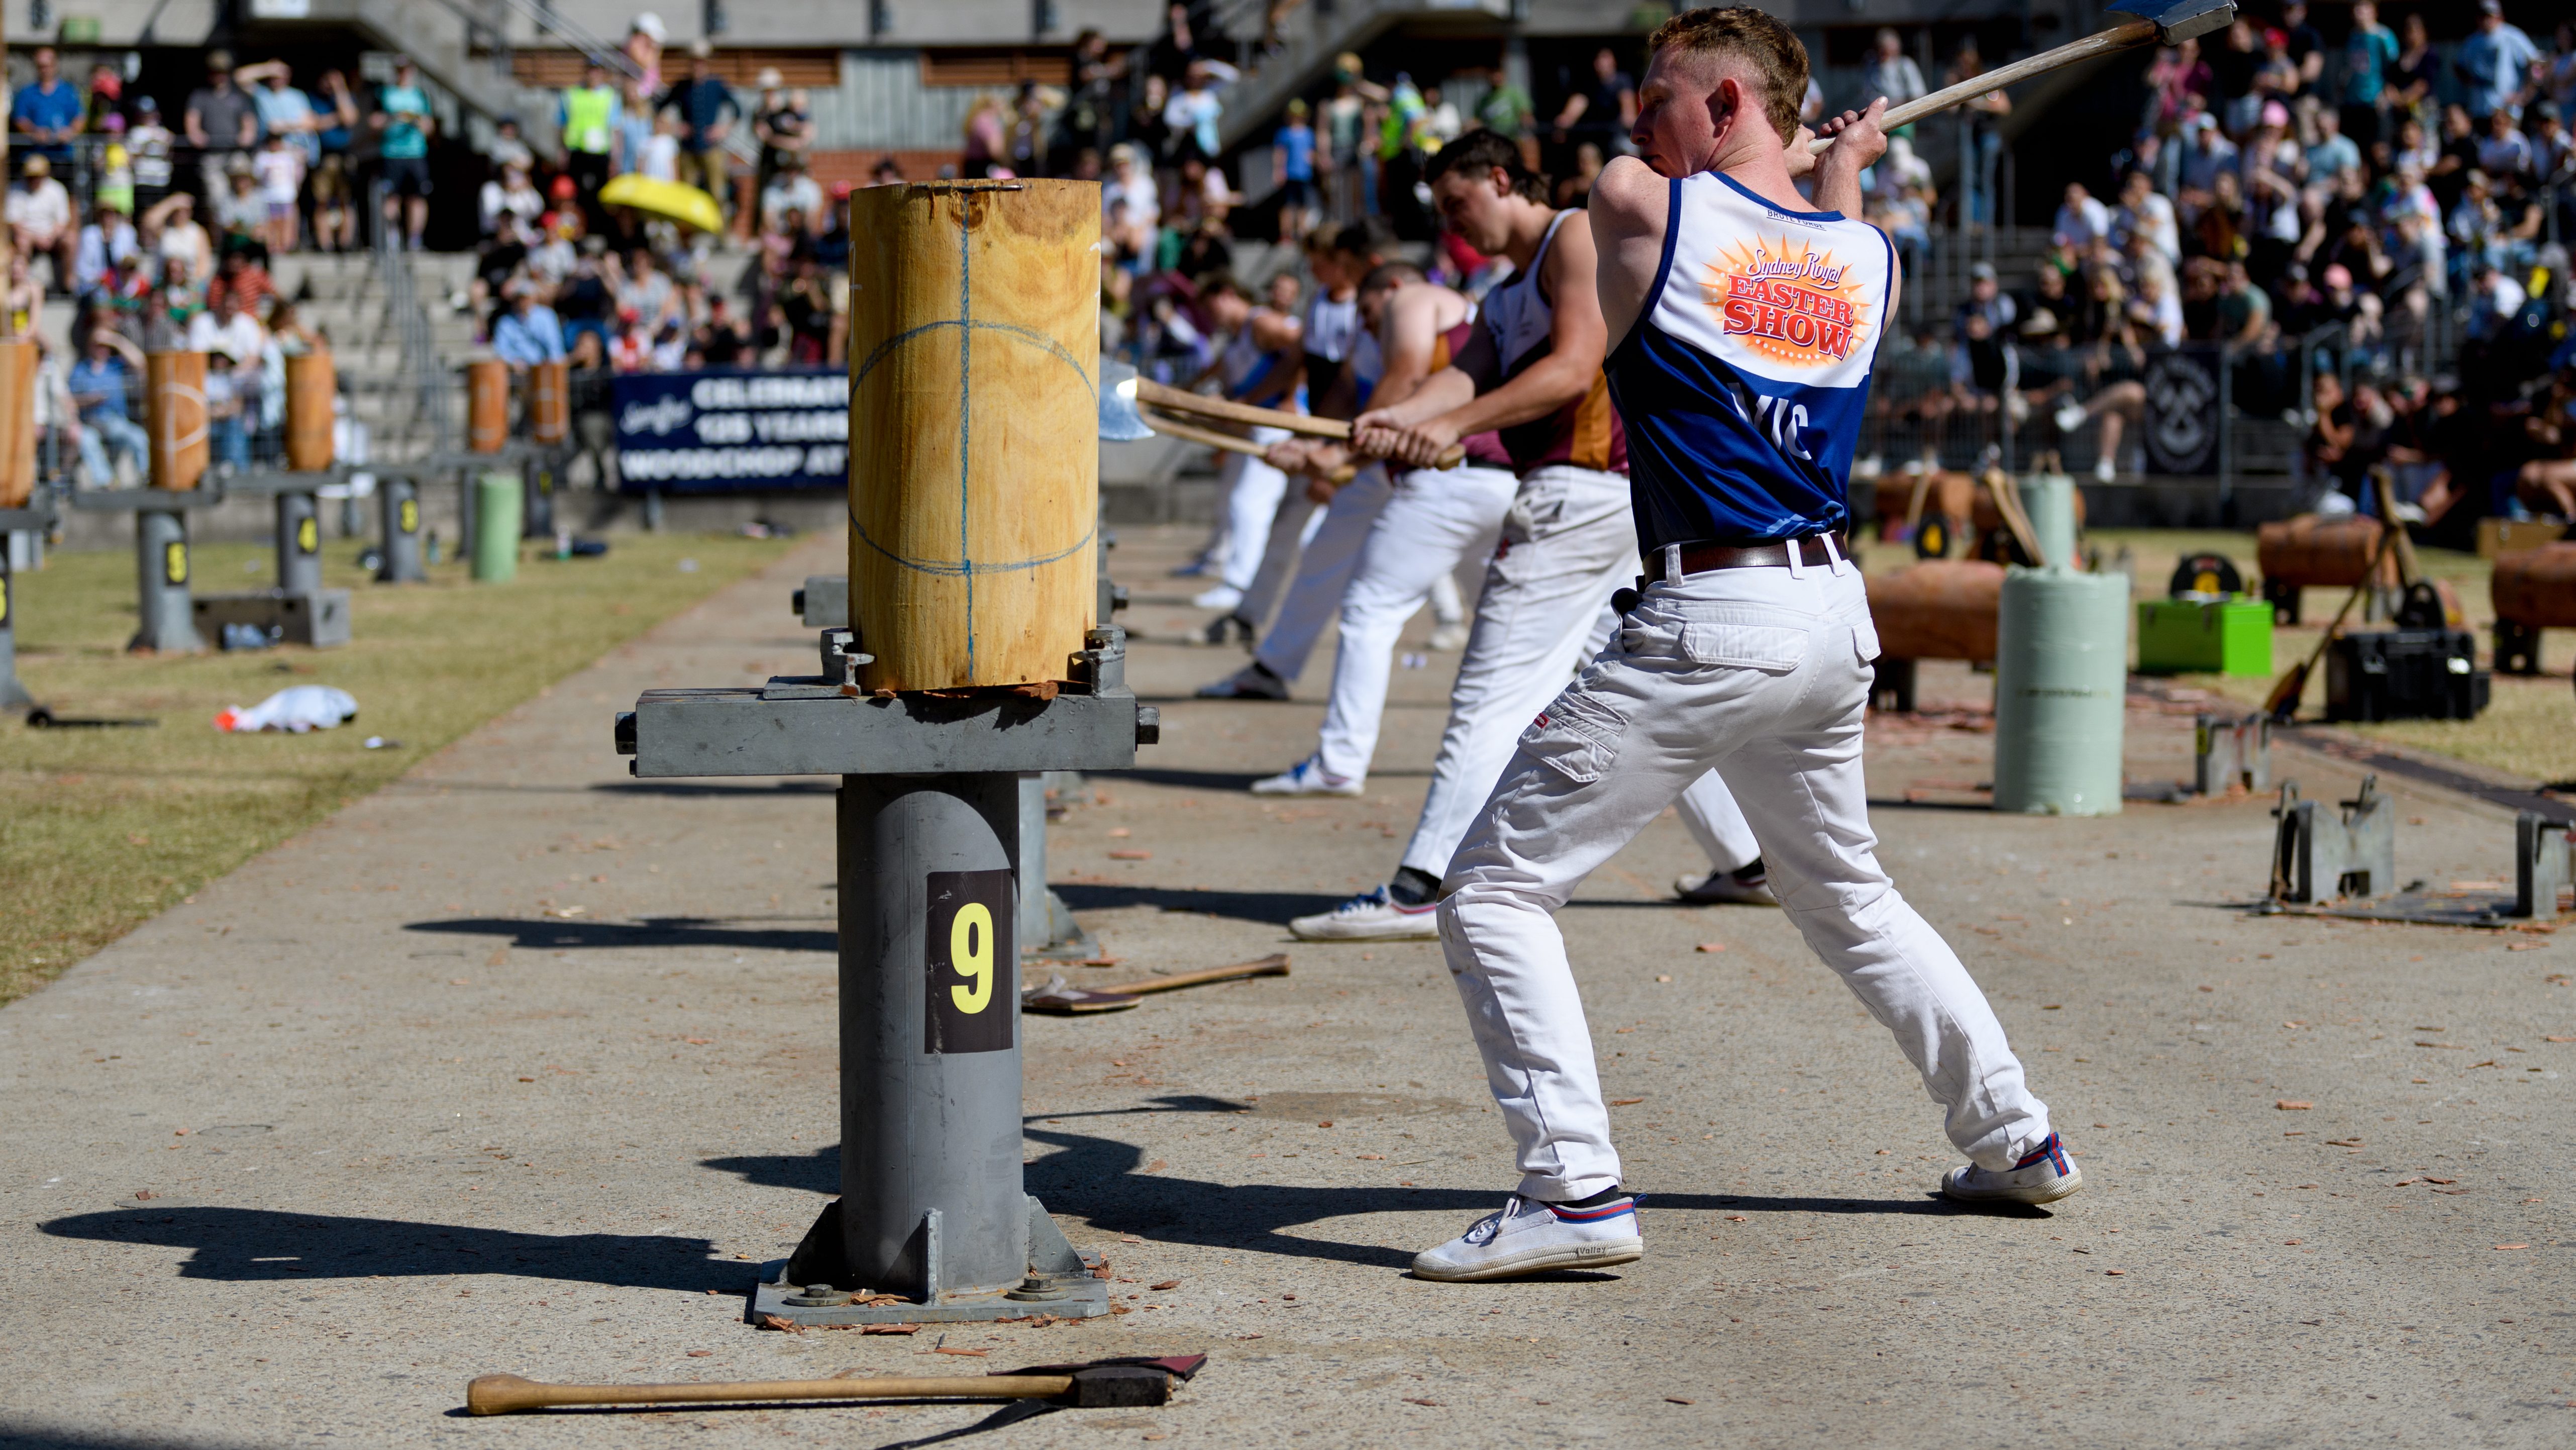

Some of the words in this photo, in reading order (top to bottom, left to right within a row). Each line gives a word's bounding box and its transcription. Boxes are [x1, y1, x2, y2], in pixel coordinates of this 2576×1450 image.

[1745, 249, 1804, 282] Sydney
[1802, 252, 1845, 288] Royal
[1727, 274, 1854, 327] EASTER
[1723, 299, 1853, 361] SHOW
[1727, 382, 1812, 460] VIC
[621, 447, 803, 480] WOODCHOP
[951, 903, 993, 1014] 9
